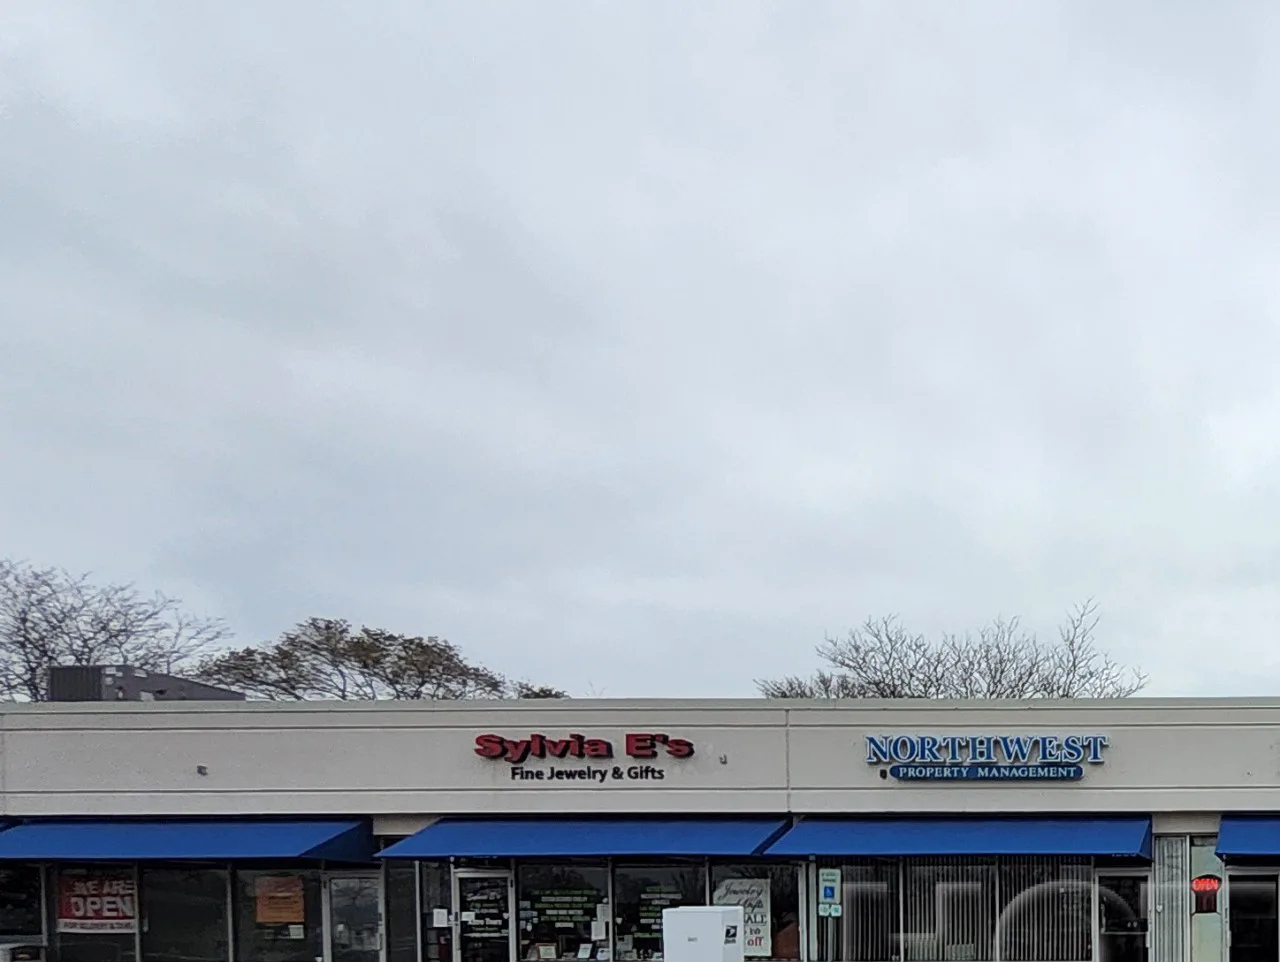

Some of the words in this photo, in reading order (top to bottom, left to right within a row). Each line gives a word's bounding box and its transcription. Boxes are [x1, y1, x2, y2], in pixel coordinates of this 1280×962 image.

[474, 733, 612, 763] Sylvia
[625, 733, 694, 758] E's
[864, 734, 1108, 763] NORTHWEST
[511, 767, 544, 780] Fine
[546, 766, 607, 783] Jewelry
[611, 767, 623, 780] &
[627, 766, 664, 780] Gifts
[899, 766, 969, 778] PROPERTY
[978, 766, 1077, 778] MANAGEMENT
[69, 896, 135, 917] OPEN
[744, 912, 768, 924] ALE
